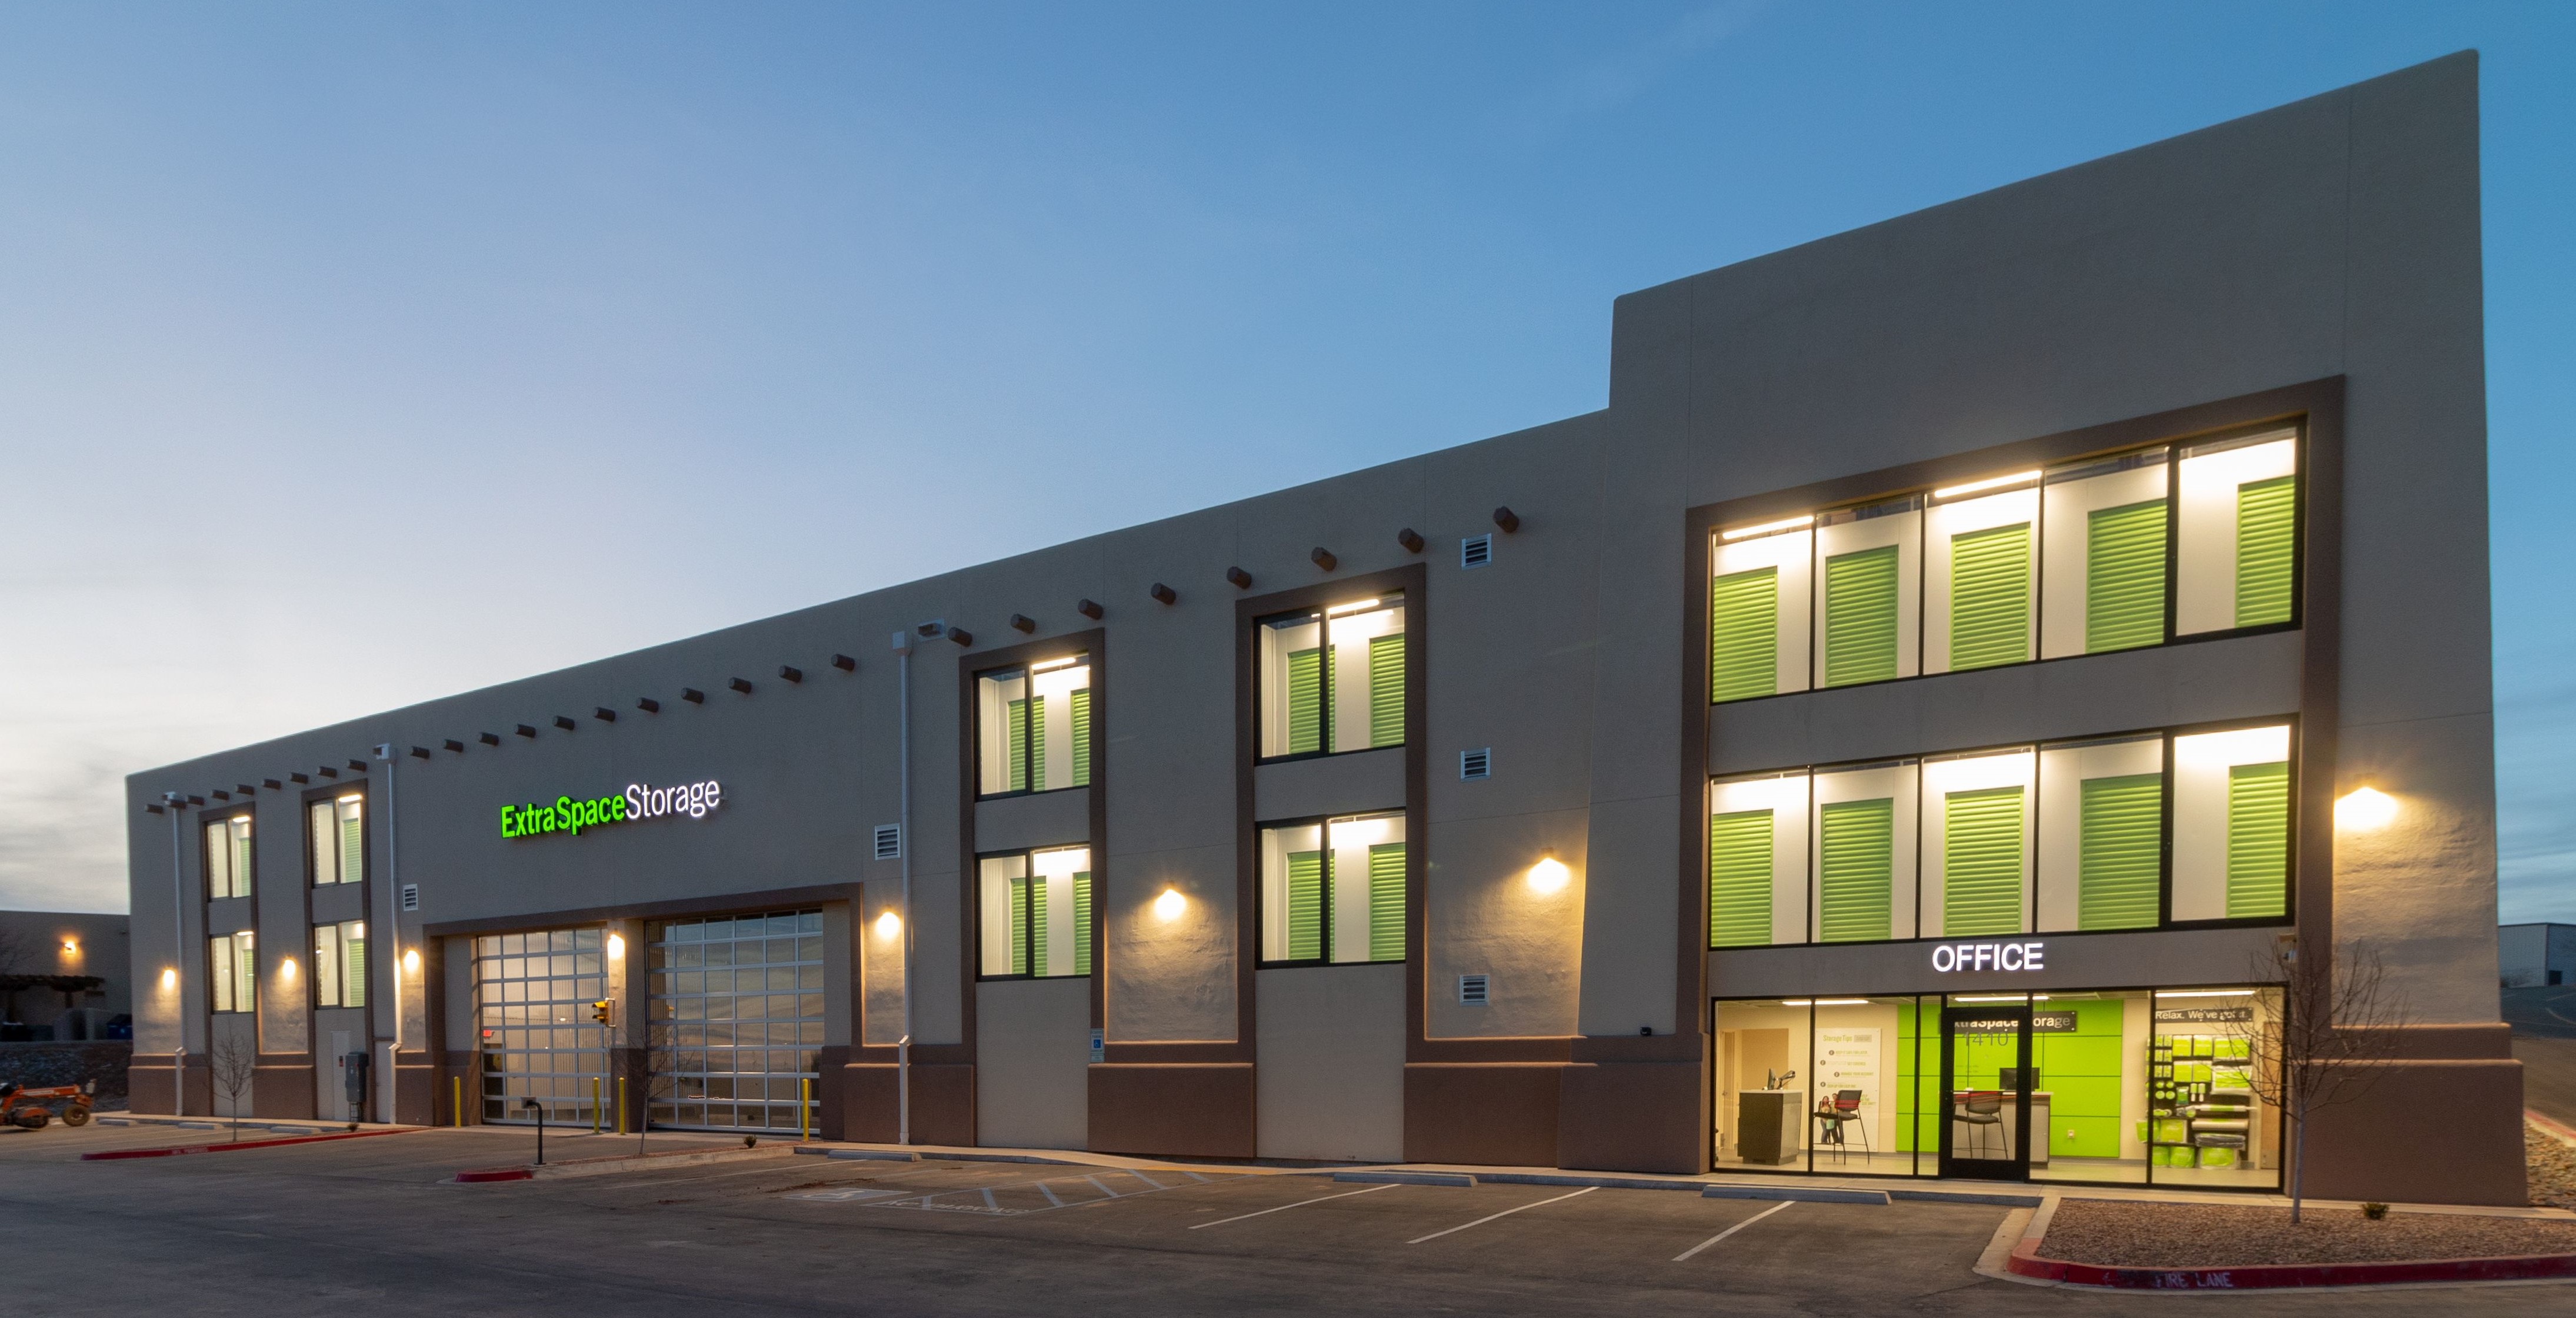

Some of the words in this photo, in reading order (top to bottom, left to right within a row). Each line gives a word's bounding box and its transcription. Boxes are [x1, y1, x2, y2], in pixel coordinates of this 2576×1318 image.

[501, 781, 721, 838] ExtraSpaceStorage
[1932, 943, 2044, 971] OFFICE
[2155, 1010, 2185, 1019] Relax.
[2188, 1010, 2217, 1019] We've
[1962, 1031, 2008, 1046] 1410
[2195, 1272, 2234, 1287] LANE
